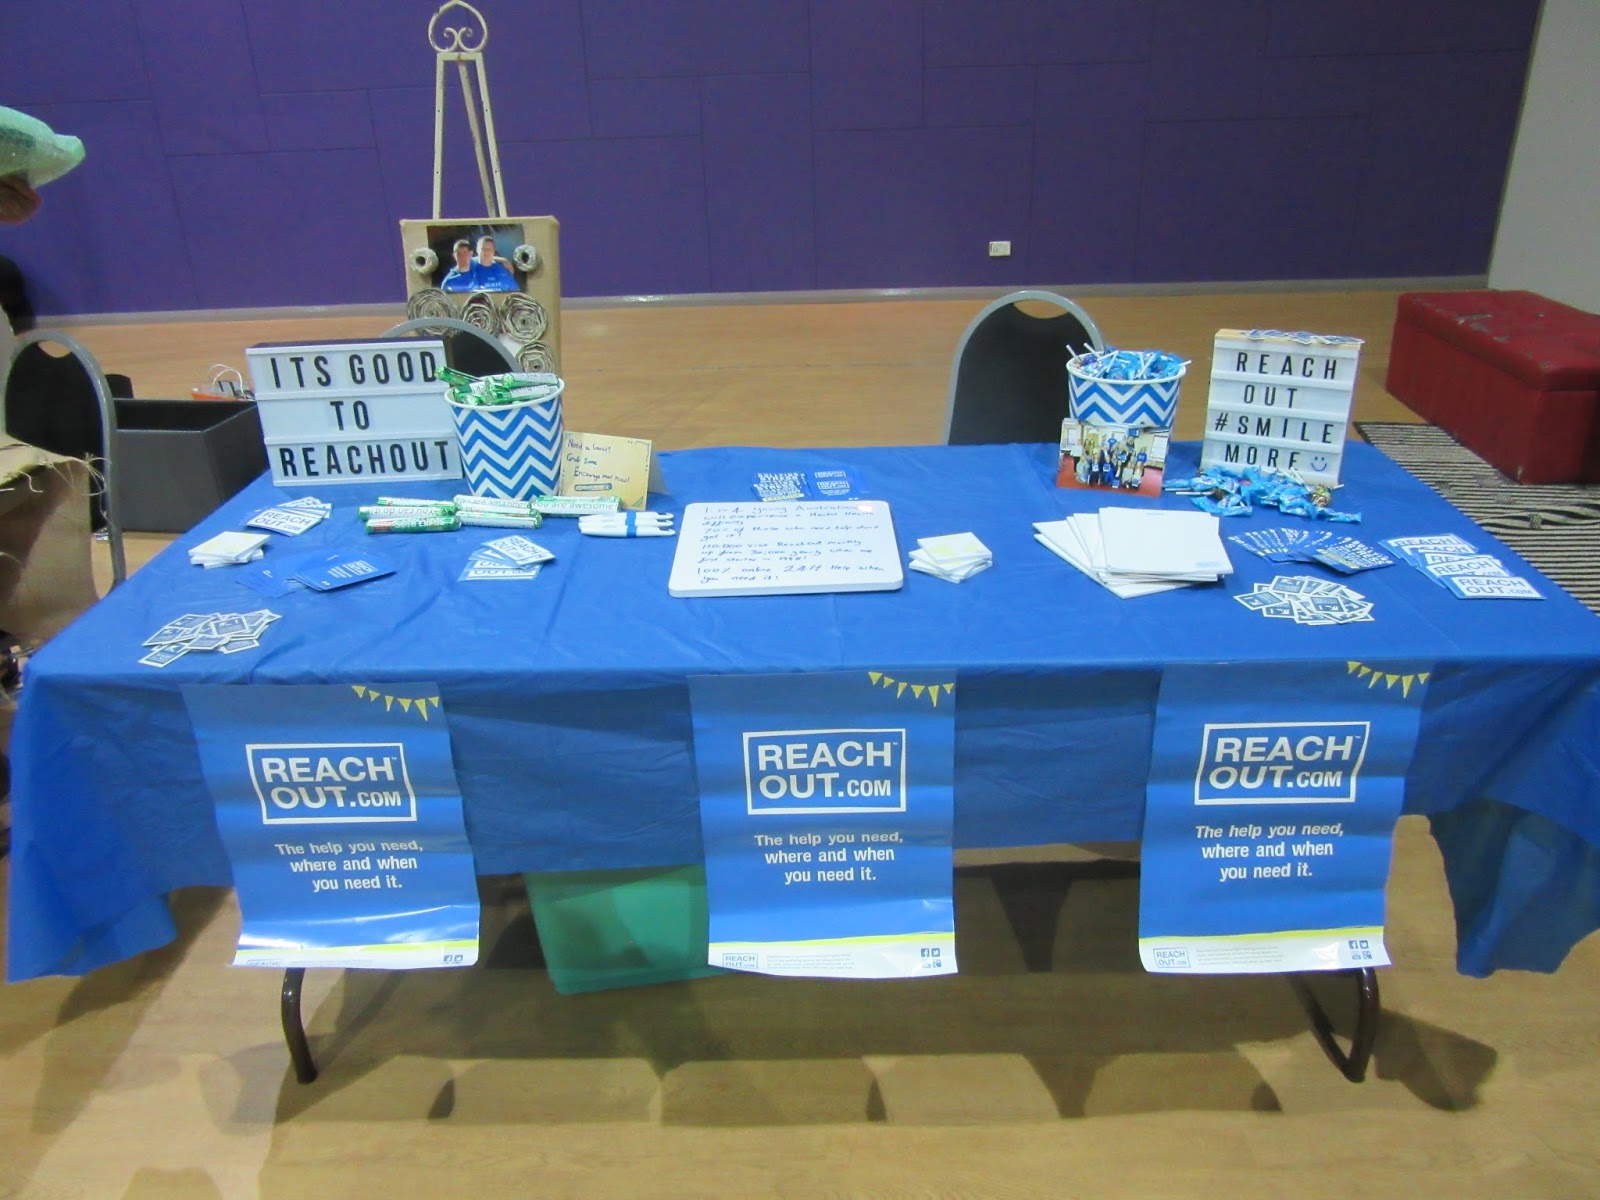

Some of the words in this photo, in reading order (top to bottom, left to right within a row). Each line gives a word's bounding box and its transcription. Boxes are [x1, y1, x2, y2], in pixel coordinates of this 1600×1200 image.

[270, 355, 331, 388] ITS
[349, 351, 437, 385] GOOD
[1236, 352, 1337, 380] REACH
[1244, 384, 1298, 409] OUT
[330, 400, 370, 431] TO
[1214, 412, 1335, 443] #SMILE
[279, 441, 449, 477] REACHOUT
[1224, 444, 1301, 471] MORE
[263, 511, 312, 525] REACH
[1433, 560, 1493, 575] REACH
[1458, 577, 1526, 588] REACH
[757, 740, 892, 771] REACH
[1214, 735, 1354, 762] REACH
[261, 756, 395, 783] REACH
[754, 834, 783, 846] The
[789, 833, 822, 847] help
[828, 834, 855, 846] you
[861, 831, 903, 843] need,
[1195, 825, 1223, 839] The
[1228, 824, 1262, 840] help
[1267, 825, 1296, 839] you
[1301, 822, 1344, 837] need,
[274, 843, 305, 855] The
[309, 841, 343, 856] help
[348, 842, 376, 855] you
[380, 840, 424, 852] need,
[764, 850, 812, 864] where
[818, 848, 847, 862] and
[853, 847, 895, 862] when
[1202, 843, 1250, 859] where
[1255, 841, 1285, 857] and
[1292, 840, 1334, 856] when
[289, 858, 337, 873] where
[343, 856, 371, 871] and
[377, 855, 418, 870] when
[1219, 866, 1247, 882] you
[1253, 862, 1291, 879] need
[1296, 862, 1313, 877] it.
[312, 878, 339, 893] you
[344, 875, 381, 890] need
[385, 874, 403, 889] it.
[784, 870, 811, 885] you
[817, 866, 855, 882] need
[860, 866, 877, 881] it.
[1156, 950, 1186, 959] REACH
